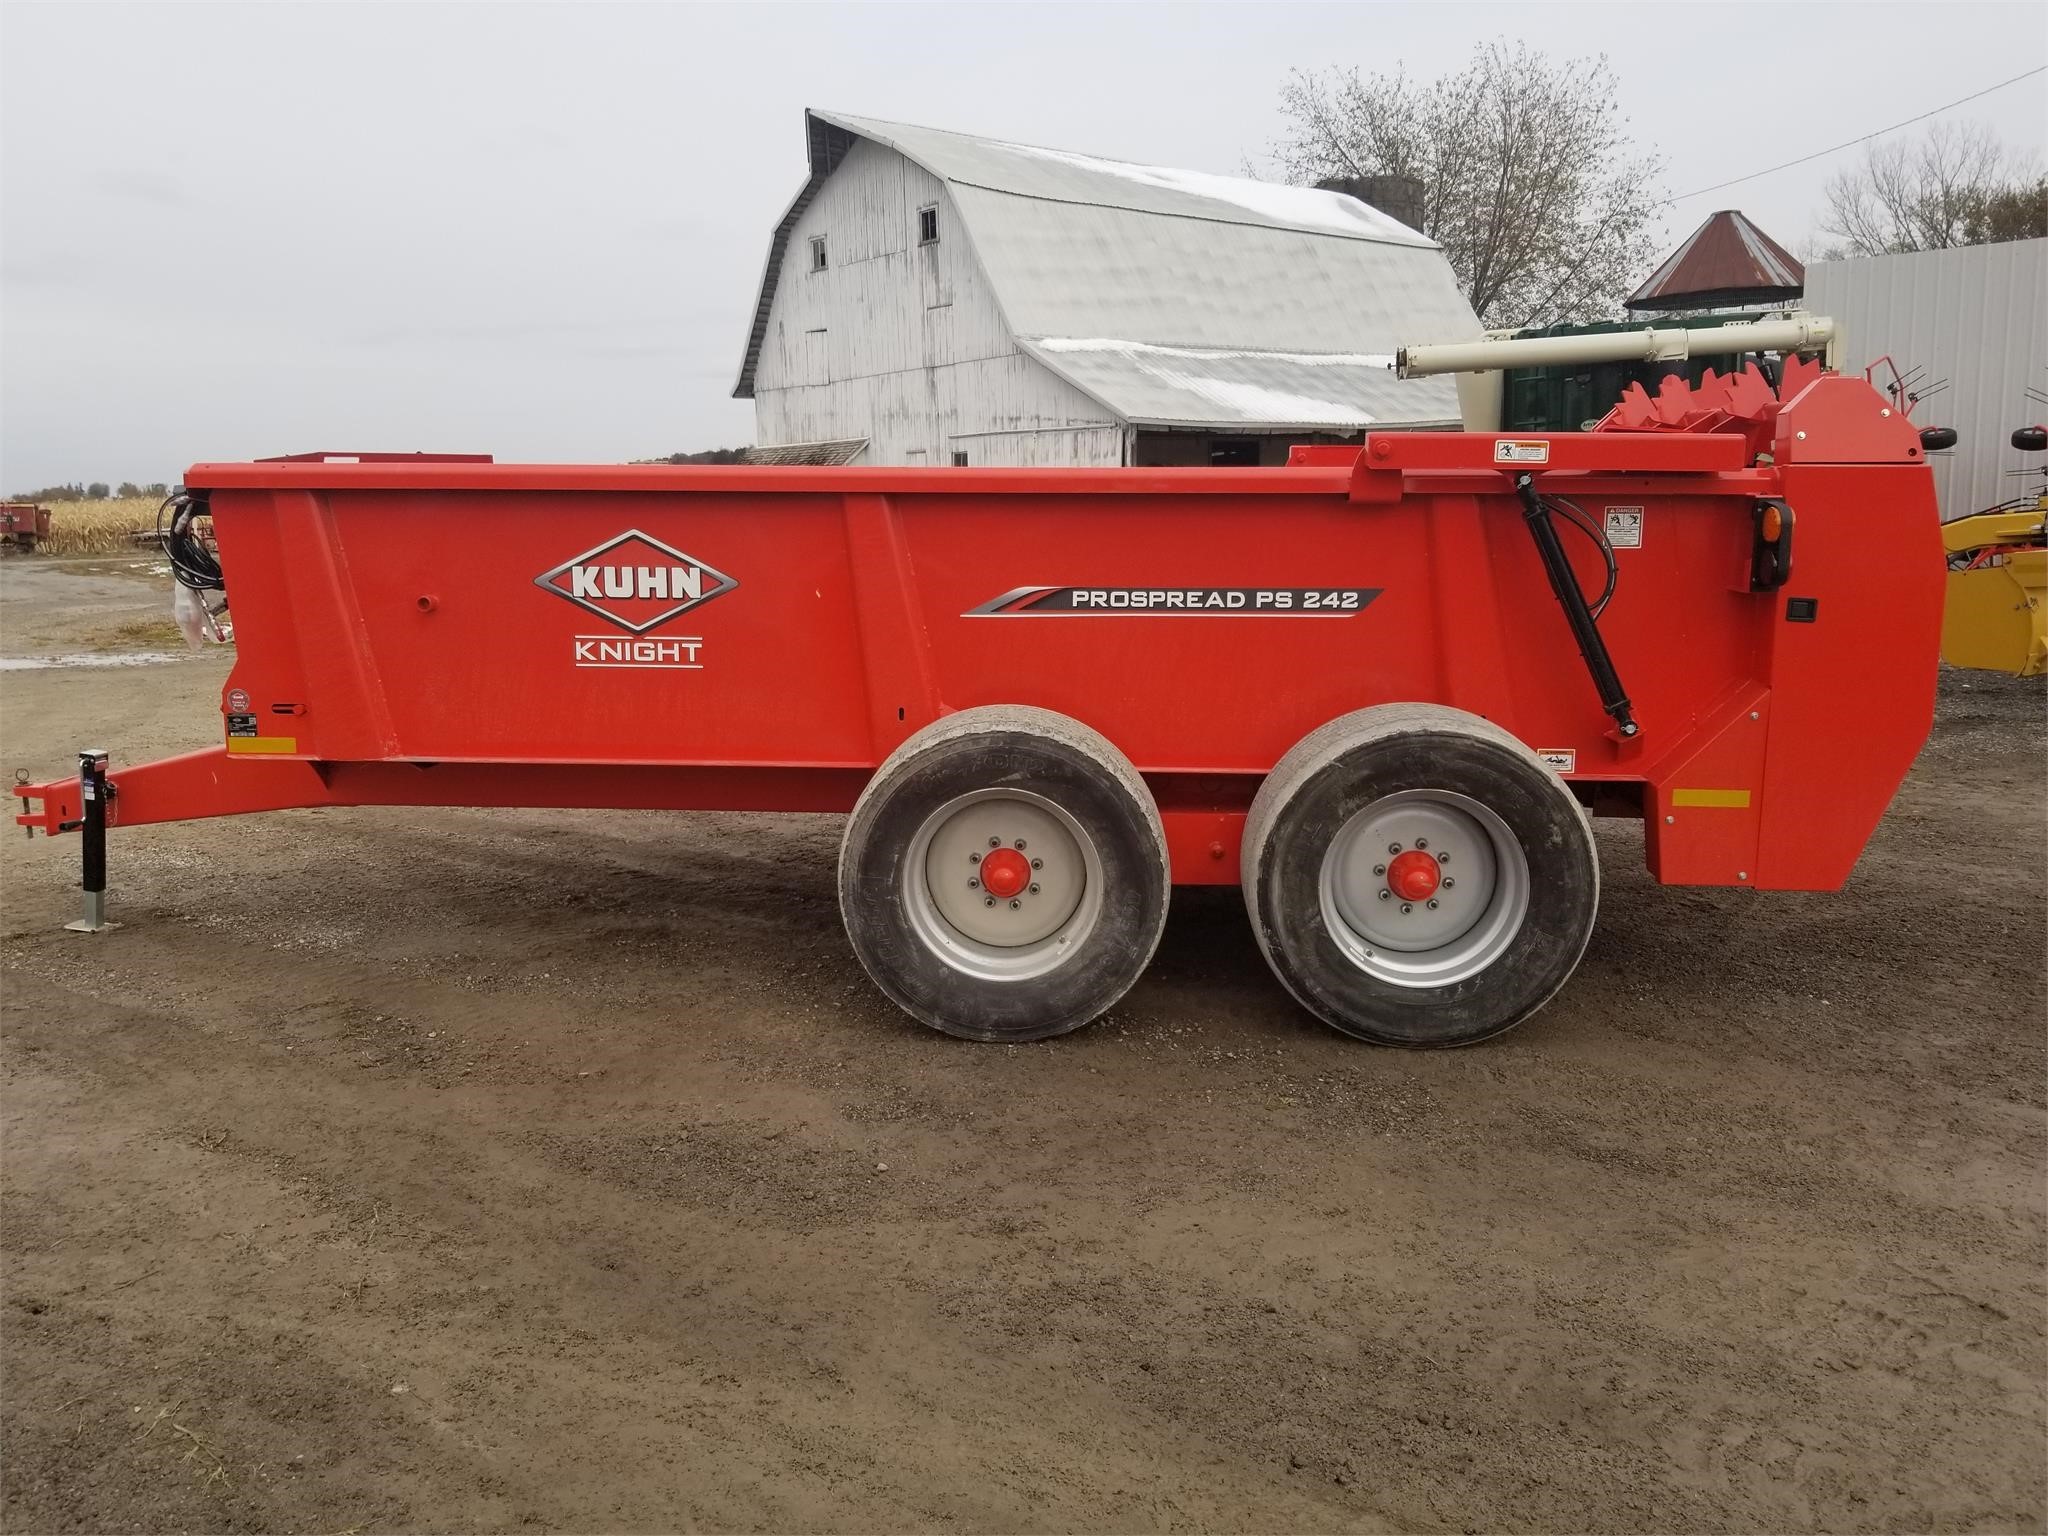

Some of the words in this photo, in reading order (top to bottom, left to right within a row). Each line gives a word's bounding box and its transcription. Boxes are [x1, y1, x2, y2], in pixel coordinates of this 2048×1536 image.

[571, 566, 702, 599] KUHN
[1072, 591, 1246, 609] PROSPREAD
[1256, 591, 1293, 609] PS
[1303, 591, 1359, 609] 242
[575, 640, 703, 662] KNIGHT
